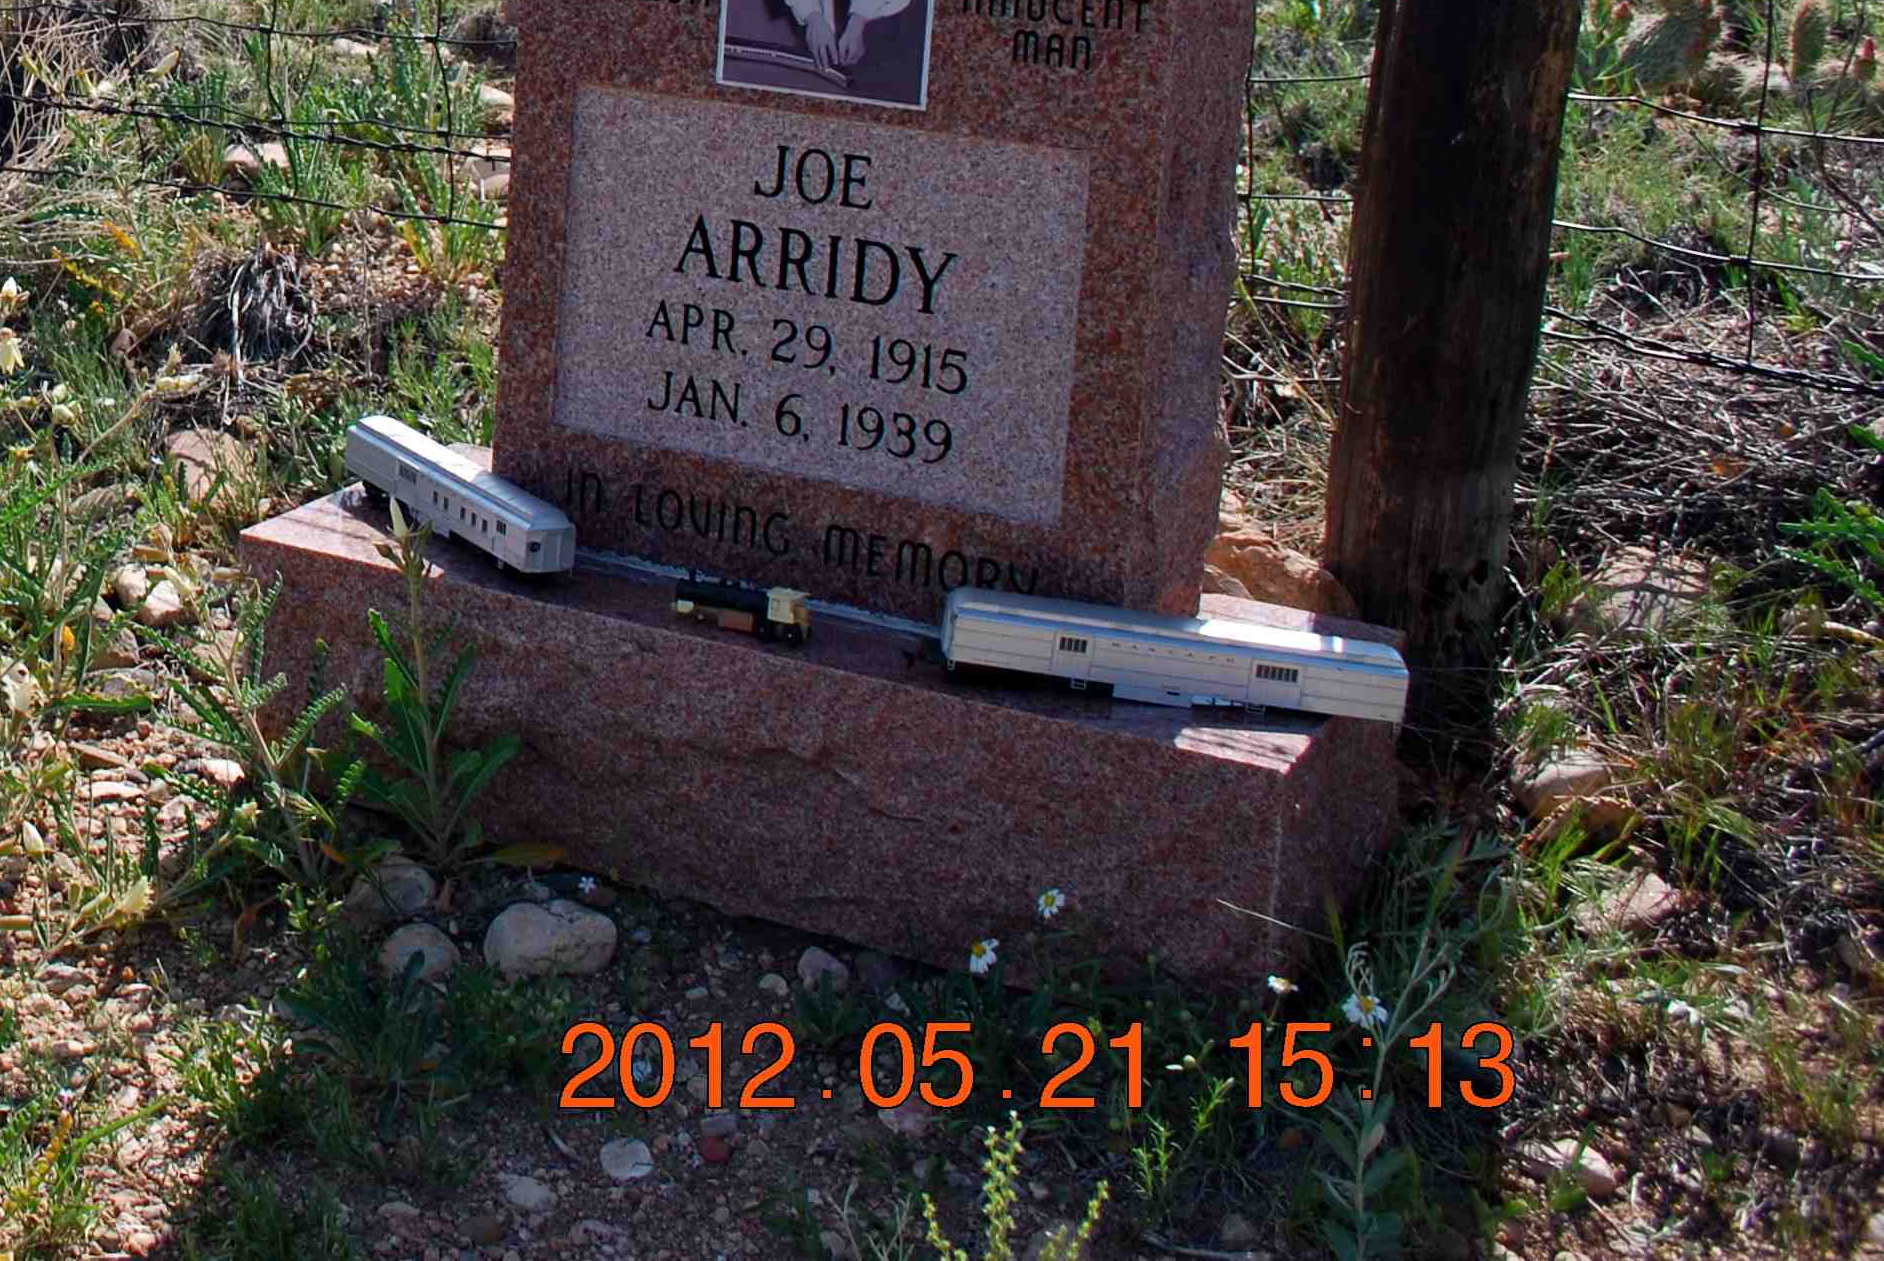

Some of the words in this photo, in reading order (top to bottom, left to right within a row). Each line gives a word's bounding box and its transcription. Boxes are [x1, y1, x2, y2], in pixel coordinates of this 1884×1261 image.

[1011, 28, 1092, 71] MAN
[753, 144, 874, 211] JOE
[672, 213, 959, 316] ARRIDY
[645, 298, 749, 357] APR.
[770, 318, 837, 377] 29,
[868, 335, 968, 395] 1915
[646, 370, 749, 428] JAN.
[774, 393, 810, 443] 6,
[837, 402, 954, 465] 1939
[565, 468, 603, 515] IN
[633, 484, 792, 557] LOVING
[822, 522, 1042, 595] MEMORY
